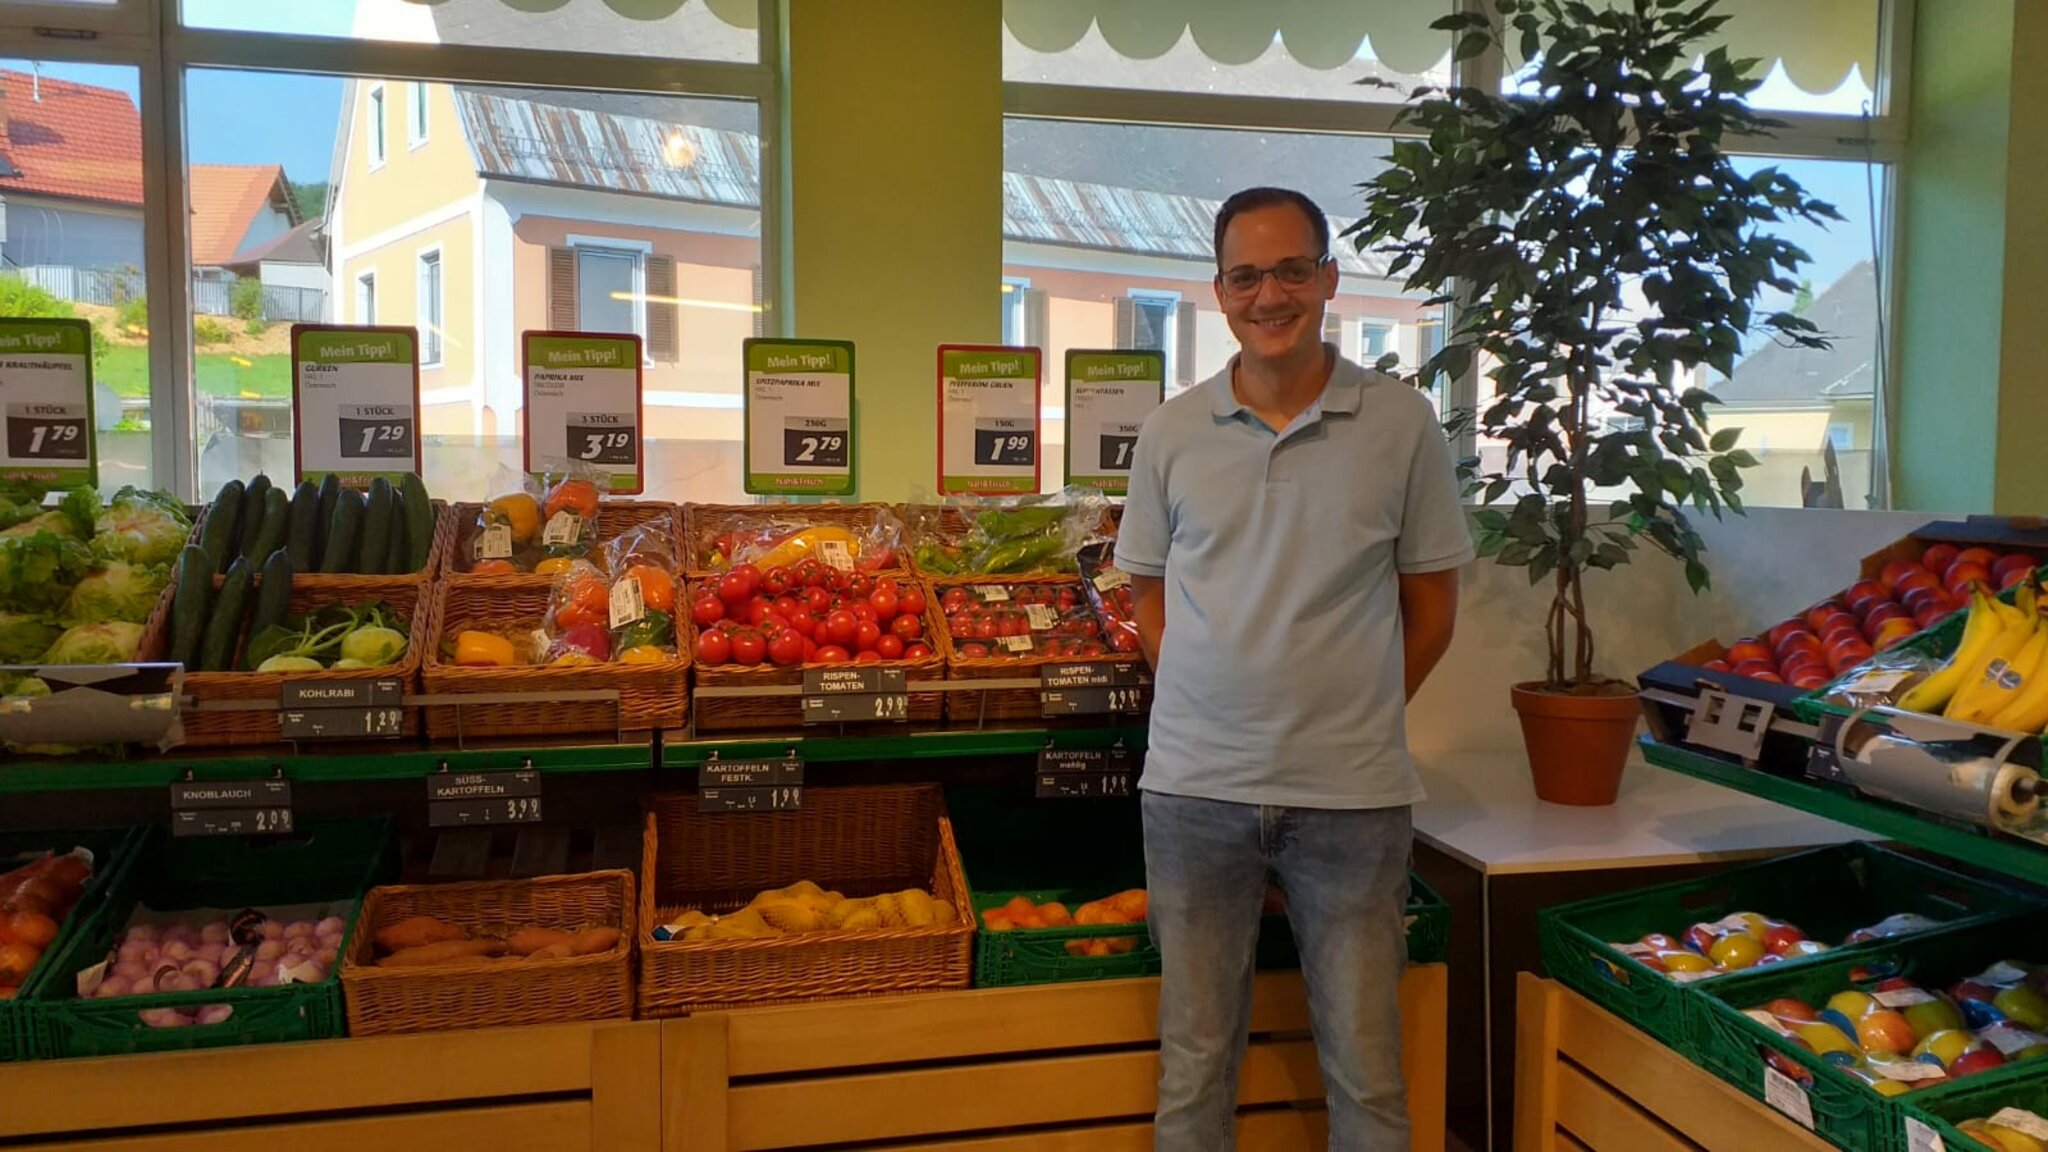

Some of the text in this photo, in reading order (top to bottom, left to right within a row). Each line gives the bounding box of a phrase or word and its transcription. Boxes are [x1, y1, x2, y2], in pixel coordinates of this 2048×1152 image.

[25, 332, 61, 348] Tipp!
[320, 343, 391, 358] Mein Tipp!
[548, 348, 617, 363] Mein Tipp!
[767, 354, 830, 368] Mein Tipp!
[960, 360, 1019, 374] Mein Tipp!
[1087, 362, 1144, 376] Mein Tipp!
[533, 373, 568, 381] PAPRIKA
[34, 404, 67, 415] STÜCK
[364, 405, 395, 416] STÜCK
[590, 414, 619, 424] STÜCK
[1115, 442, 1131, 465] 1
[823, 672, 860, 680] RISPEN-
[1048, 675, 1108, 686] TOMATEN midi
[820, 682, 864, 691] TOMATEN
[299, 689, 354, 698] KOHLRABI
[1045, 751, 1101, 760] KARTOFFELN
[707, 764, 769, 773] KARTOFFELN
[721, 774, 754, 782] FESTK.
[183, 789, 252, 800] KNOBLAUCH
[437, 785, 504, 796] KARTOFFELN
